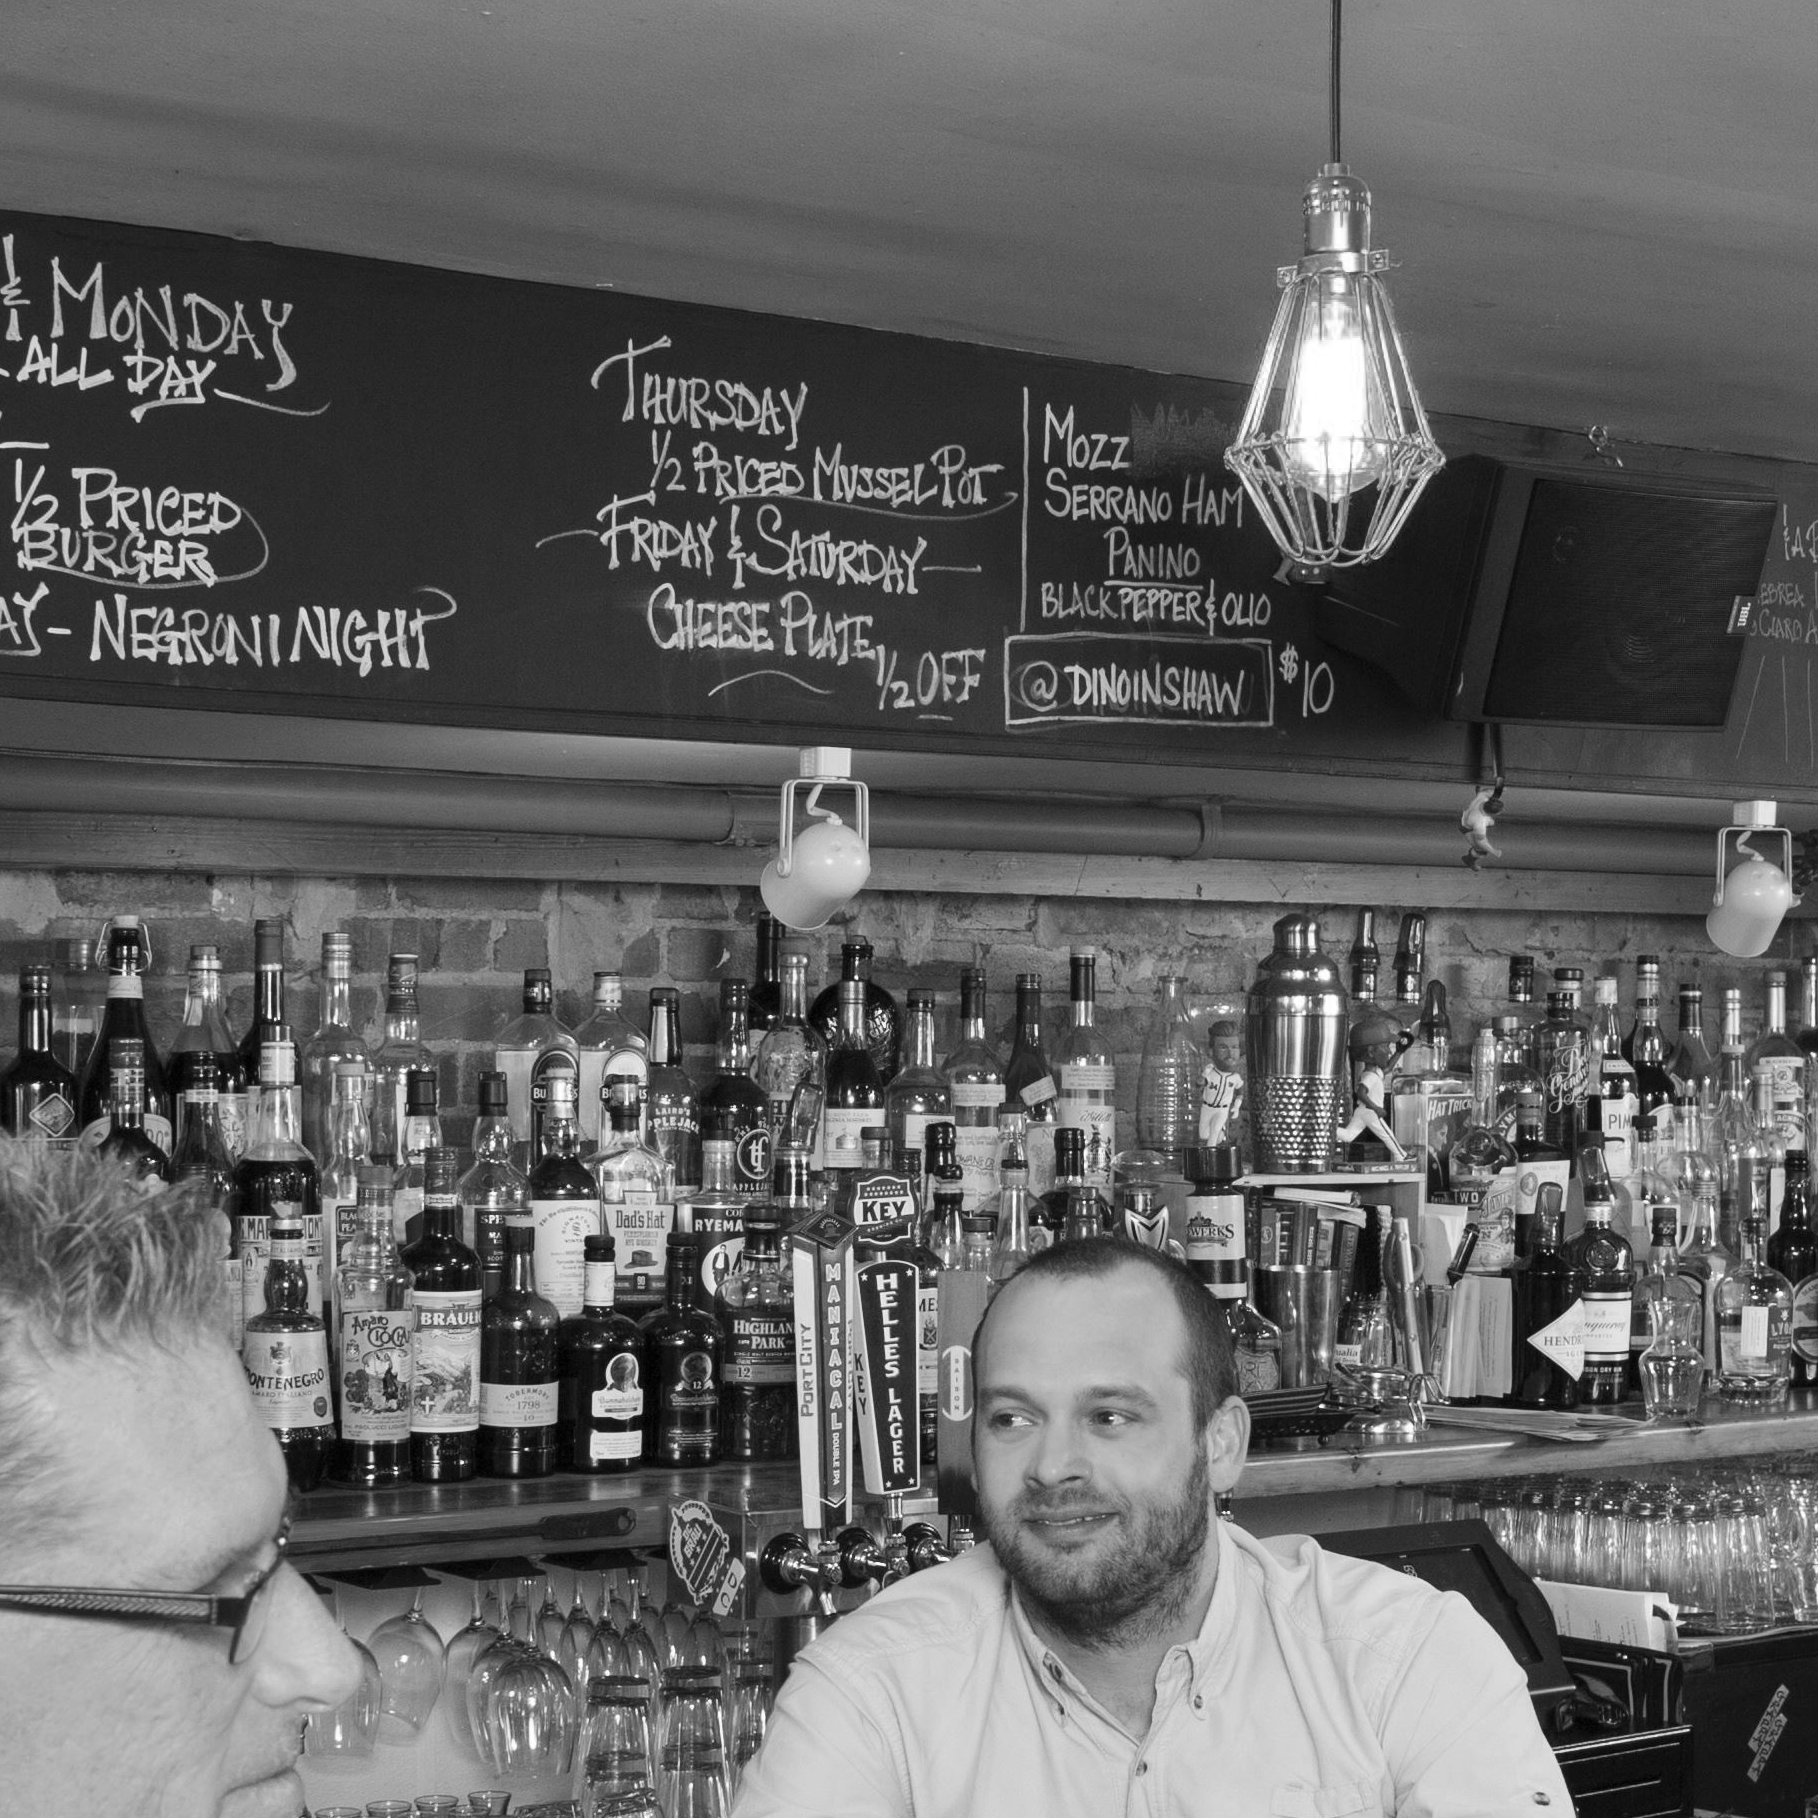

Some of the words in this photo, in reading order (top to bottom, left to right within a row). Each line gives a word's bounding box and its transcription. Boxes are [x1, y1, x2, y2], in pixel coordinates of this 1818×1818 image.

[51, 257, 297, 392] MONDAY
[17, 338, 114, 389] ALL
[124, 351, 218, 418] DAY
[592, 337, 808, 449] THURSDAY
[1044, 403, 1131, 472] MOZZ
[693, 442, 806, 499] PRICED
[813, 443, 940, 506] MUSSEL
[934, 443, 1005, 506] POT
[70, 467, 242, 535] PRICED
[1044, 472, 1174, 526] SERRANO
[1182, 474, 1244, 528] HAM
[17, 527, 218, 588] BURGER
[597, 491, 718, 570] FRIDAY
[744, 503, 928, 595] SATURDAY
[1106, 530, 1202, 579] PANINO
[646, 582, 774, 655] CHEESE
[781, 591, 878, 664] PLATE
[1040, 582, 1116, 620] BLACK
[1117, 586, 1203, 628] PEPPER
[89, 592, 279, 666] NEGRONI
[289, 587, 456, 677] NIGHT
[916, 646, 986, 705] OFF
[647, 1117, 700, 1134] PPLEJACK
[1428, 1099, 1448, 1121] HAT
[1448, 1098, 1473, 1116] TRICK
[1608, 1113, 1632, 1130] PIM
[615, 1209, 645, 1229] Dad's
[646, 1209, 669, 1229] Hat
[694, 1217, 745, 1233] RYEMA
[861, 1199, 907, 1222] KEY
[351, 1315, 390, 1335] Amaro
[733, 1318, 796, 1336] HIGHLAN
[750, 1335, 787, 1350] PARK
[798, 1322, 814, 1367] CITY
[824, 1262, 844, 1431] MANIACAL
[875, 1272, 901, 1379] HELLES
[1543, 1335, 1584, 1347] HENDR
[692, 1380, 703, 1389] 12
[737, 1365, 752, 1379] 12
[799, 1370, 815, 1418] PORT
[853, 1352, 868, 1417] KEY
[515, 1400, 541, 1410] 1798
[886, 1386, 906, 1475] LAGER
